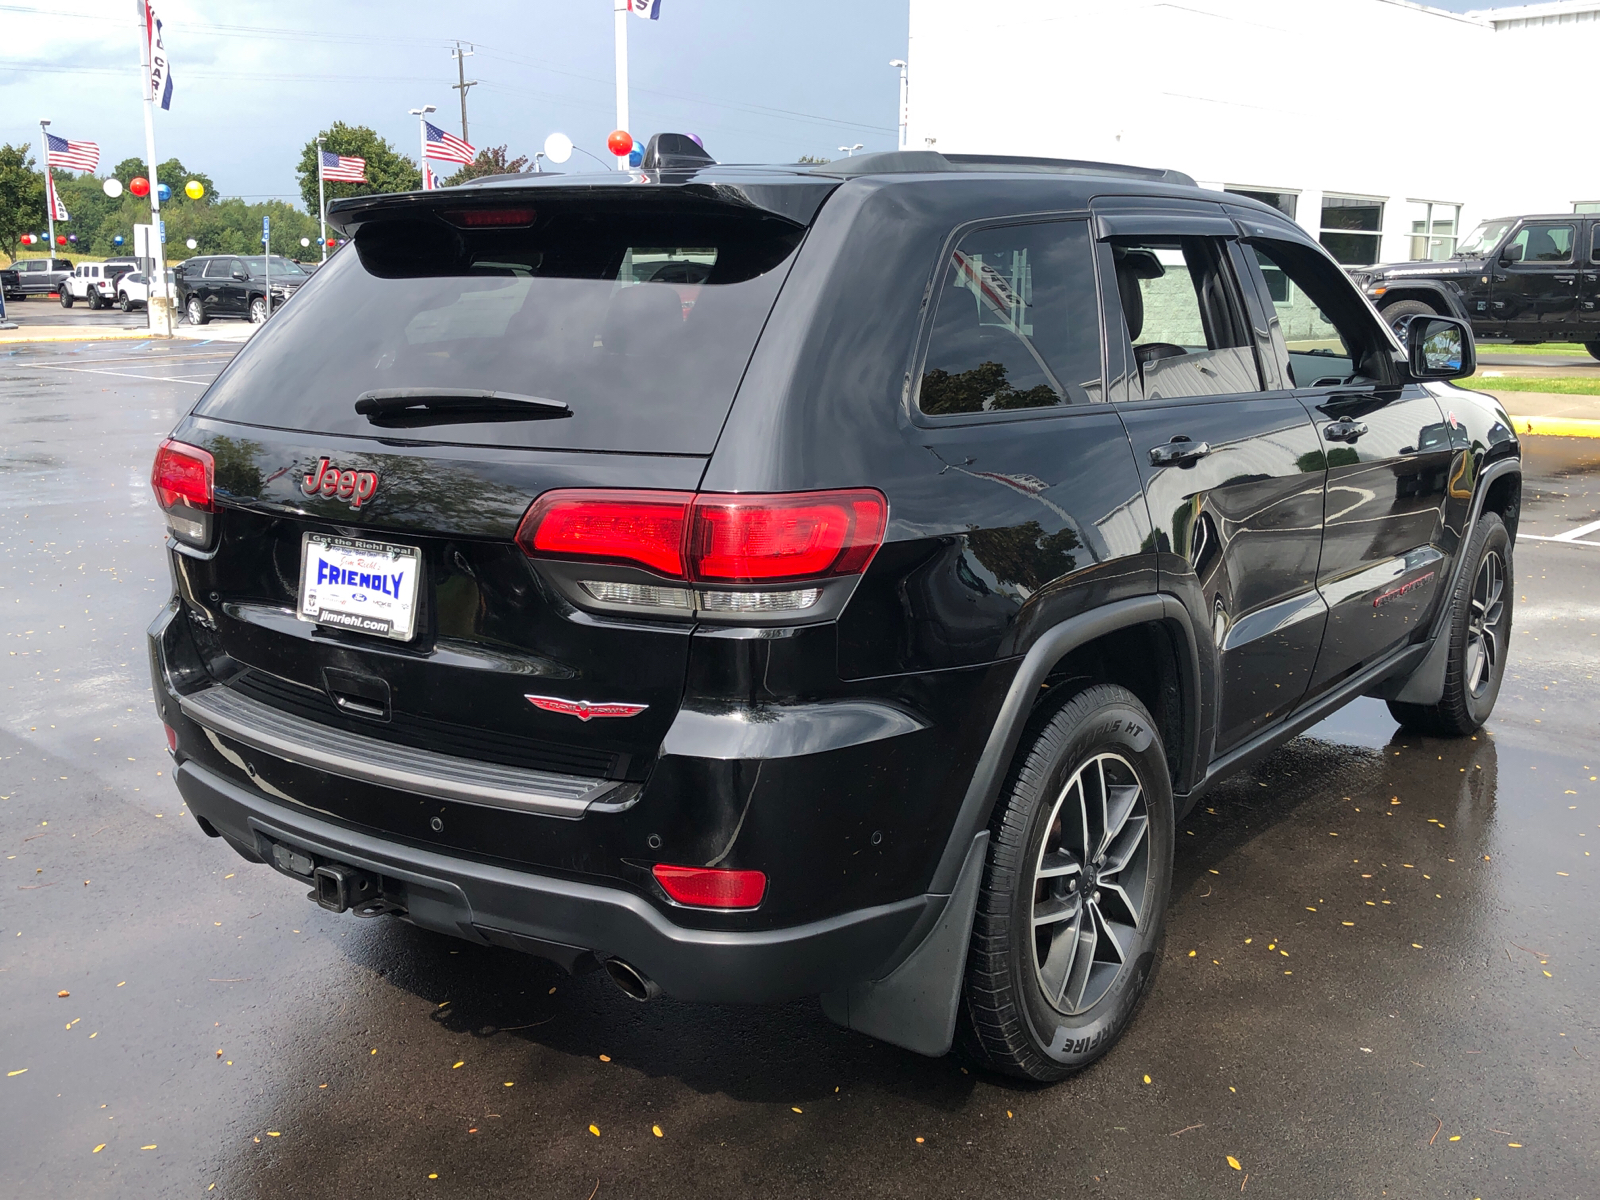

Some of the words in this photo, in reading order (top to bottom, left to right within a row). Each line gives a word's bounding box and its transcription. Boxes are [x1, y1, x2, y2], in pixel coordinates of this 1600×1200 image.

[302, 456, 378, 507] Jeep
[312, 535, 331, 544] Get
[334, 538, 352, 546] the
[355, 540, 383, 551] Riehl
[386, 546, 411, 555] Deal
[317, 557, 404, 600] FRIENDLY
[320, 611, 388, 632] jimriehl.com
[1125, 721, 1144, 738] HT
